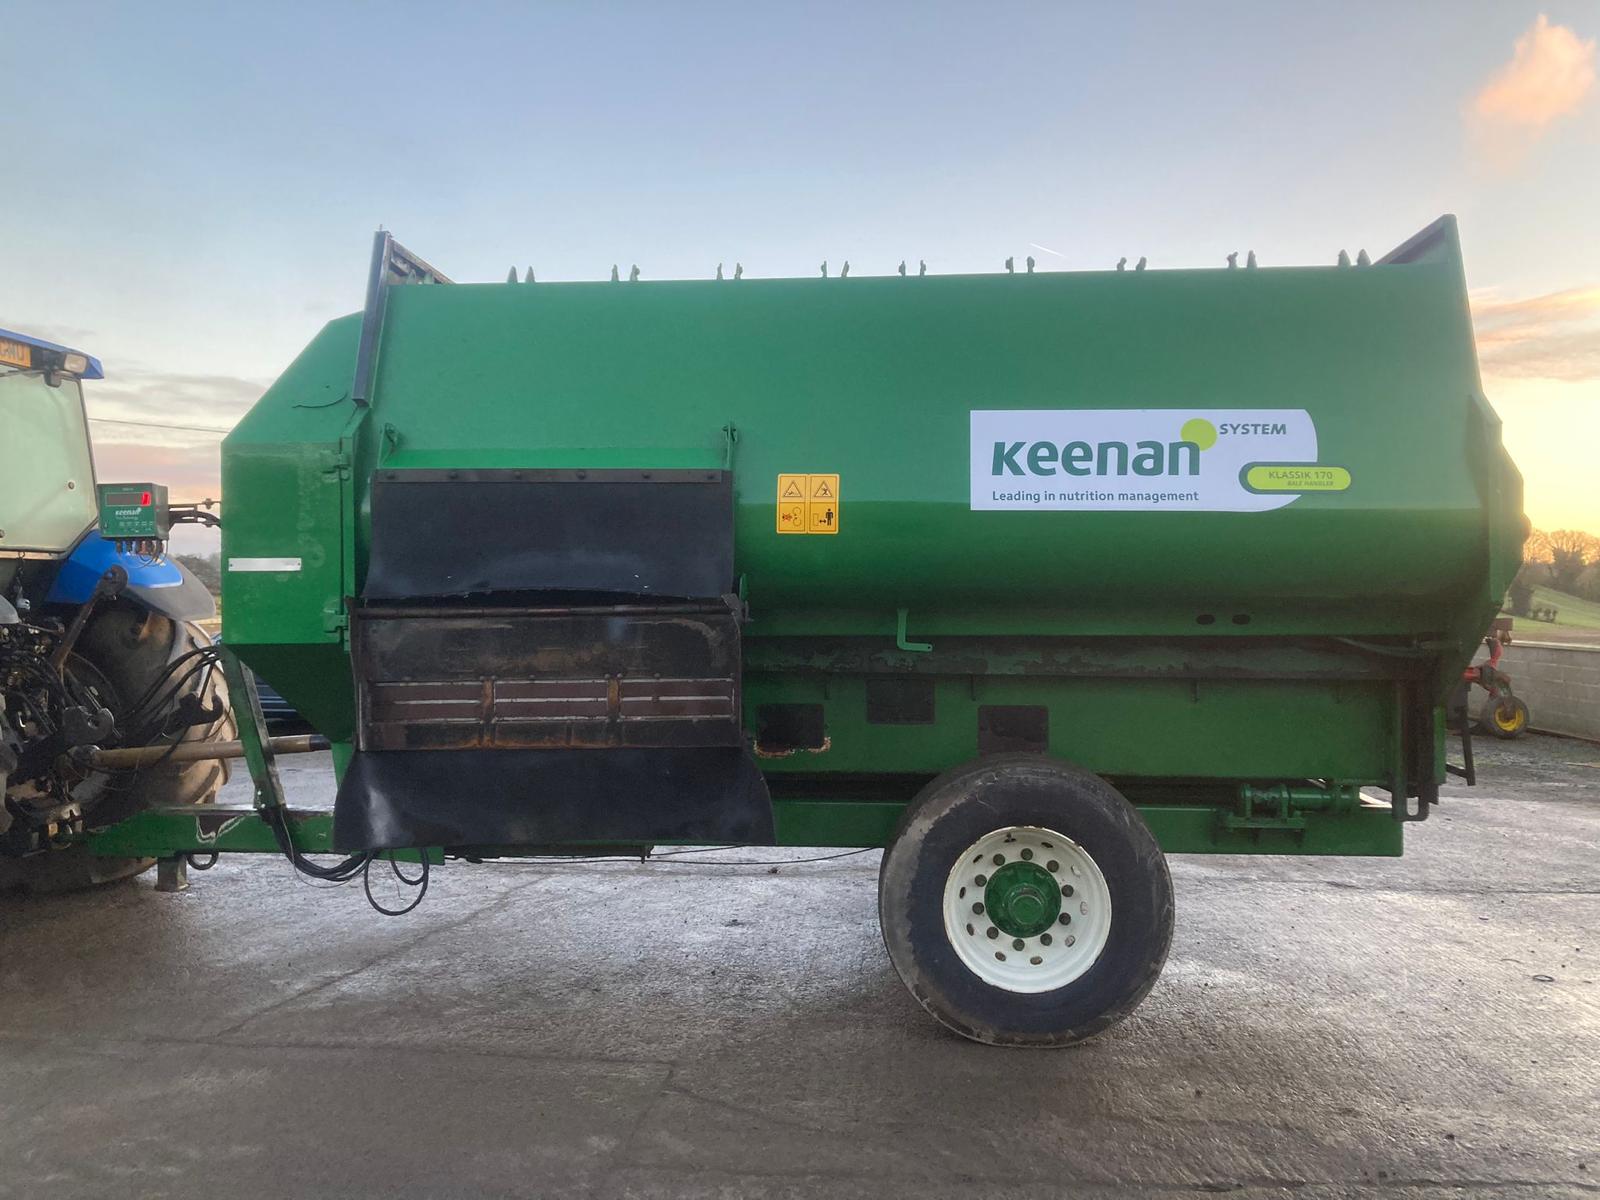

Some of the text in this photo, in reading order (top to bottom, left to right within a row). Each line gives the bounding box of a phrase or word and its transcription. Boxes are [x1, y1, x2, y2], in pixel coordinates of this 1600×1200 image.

[1219, 423, 1287, 435] SYSTEM
[1268, 471, 1334, 480] KLASSIK 170
[992, 490, 1199, 503] Leading in nutrition management
